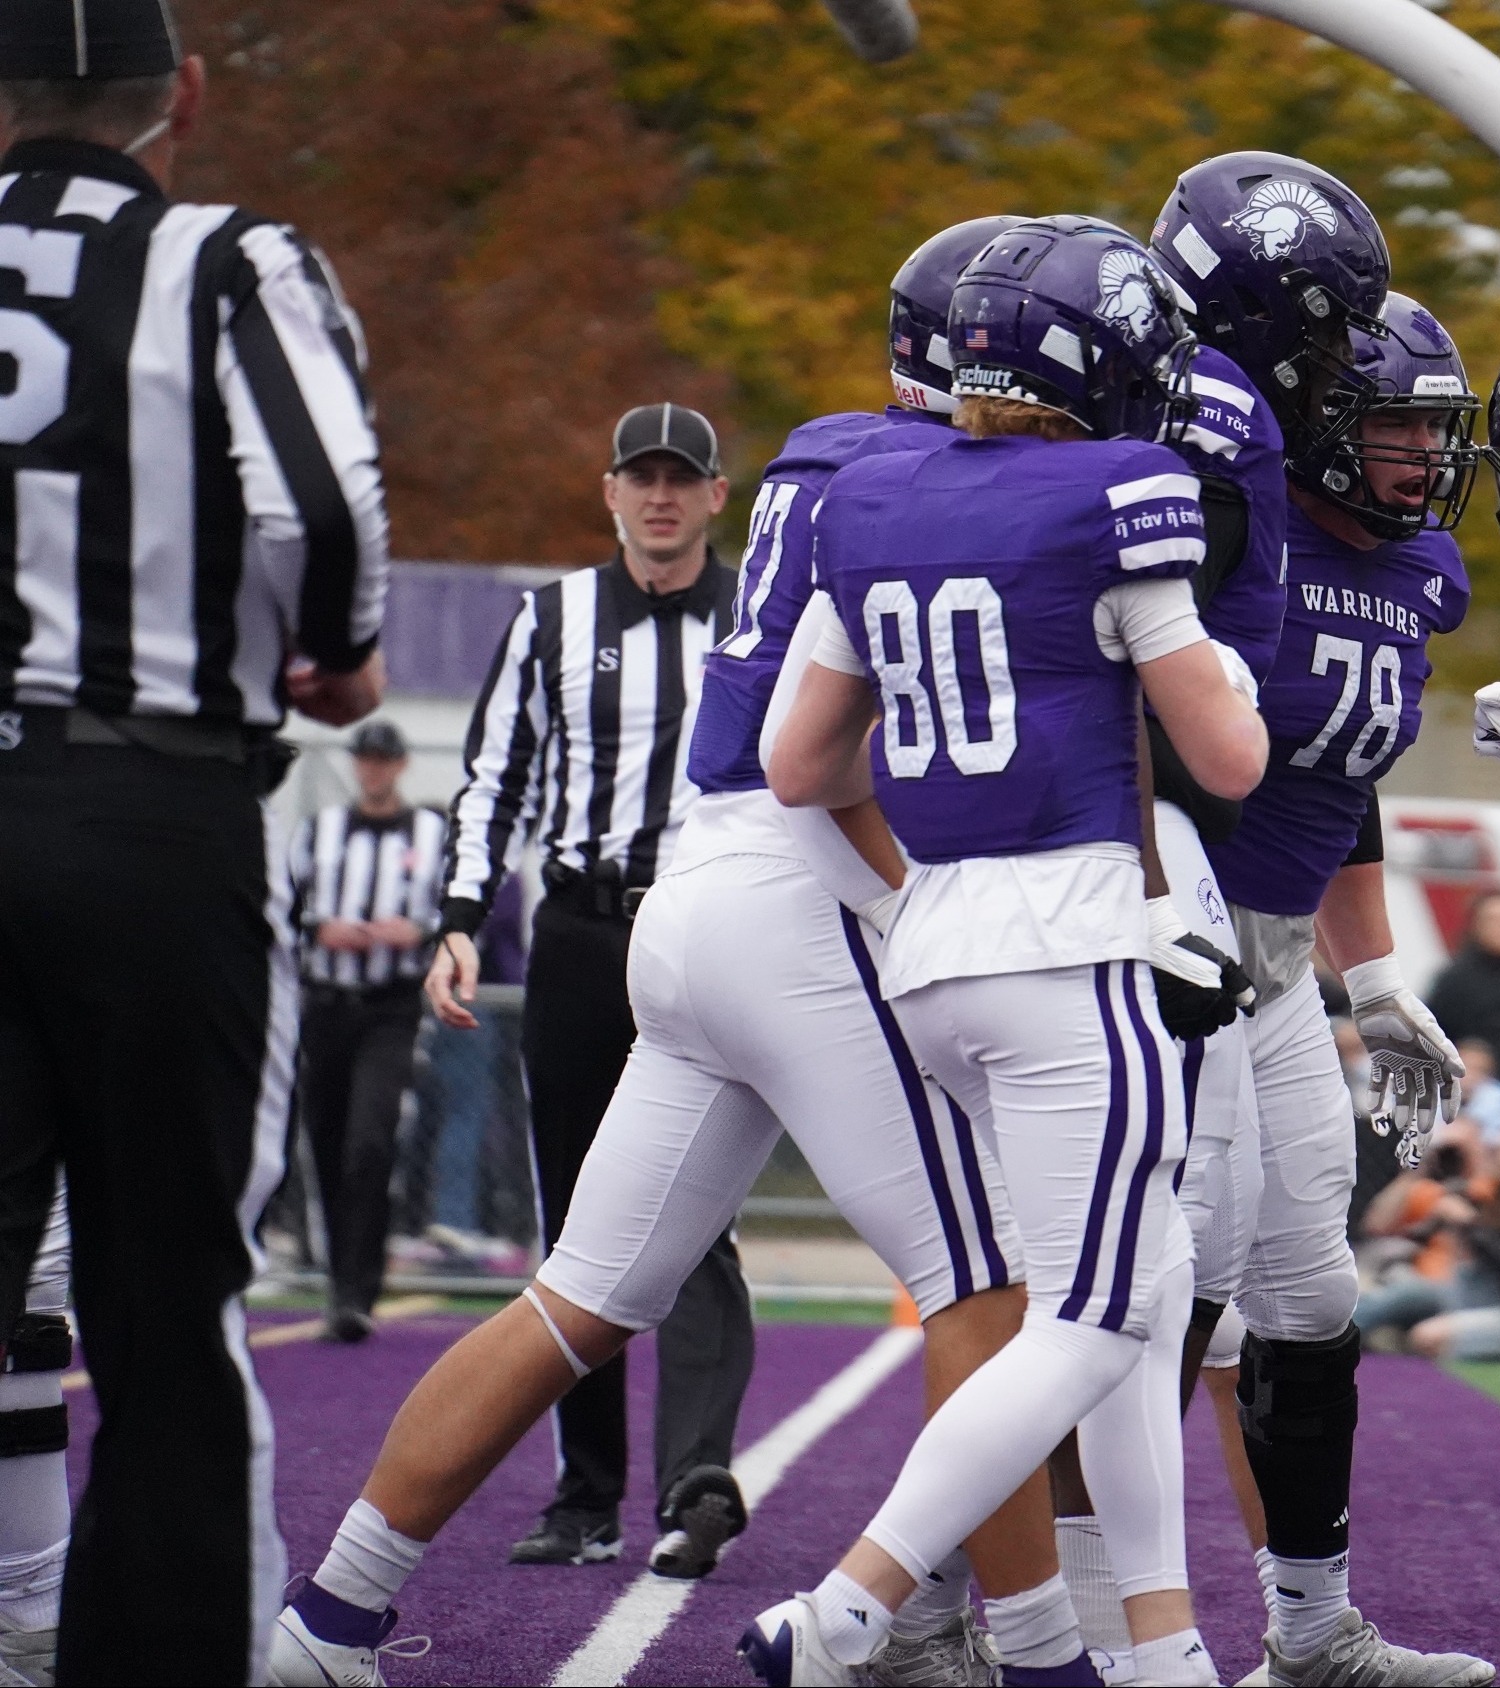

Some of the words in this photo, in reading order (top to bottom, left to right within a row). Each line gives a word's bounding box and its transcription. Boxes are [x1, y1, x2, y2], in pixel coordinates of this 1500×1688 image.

[958, 364, 1013, 387] schutt
[1301, 583, 1419, 639] WARRIORS
[863, 577, 1018, 779] 80
[1288, 632, 1403, 777] 78
